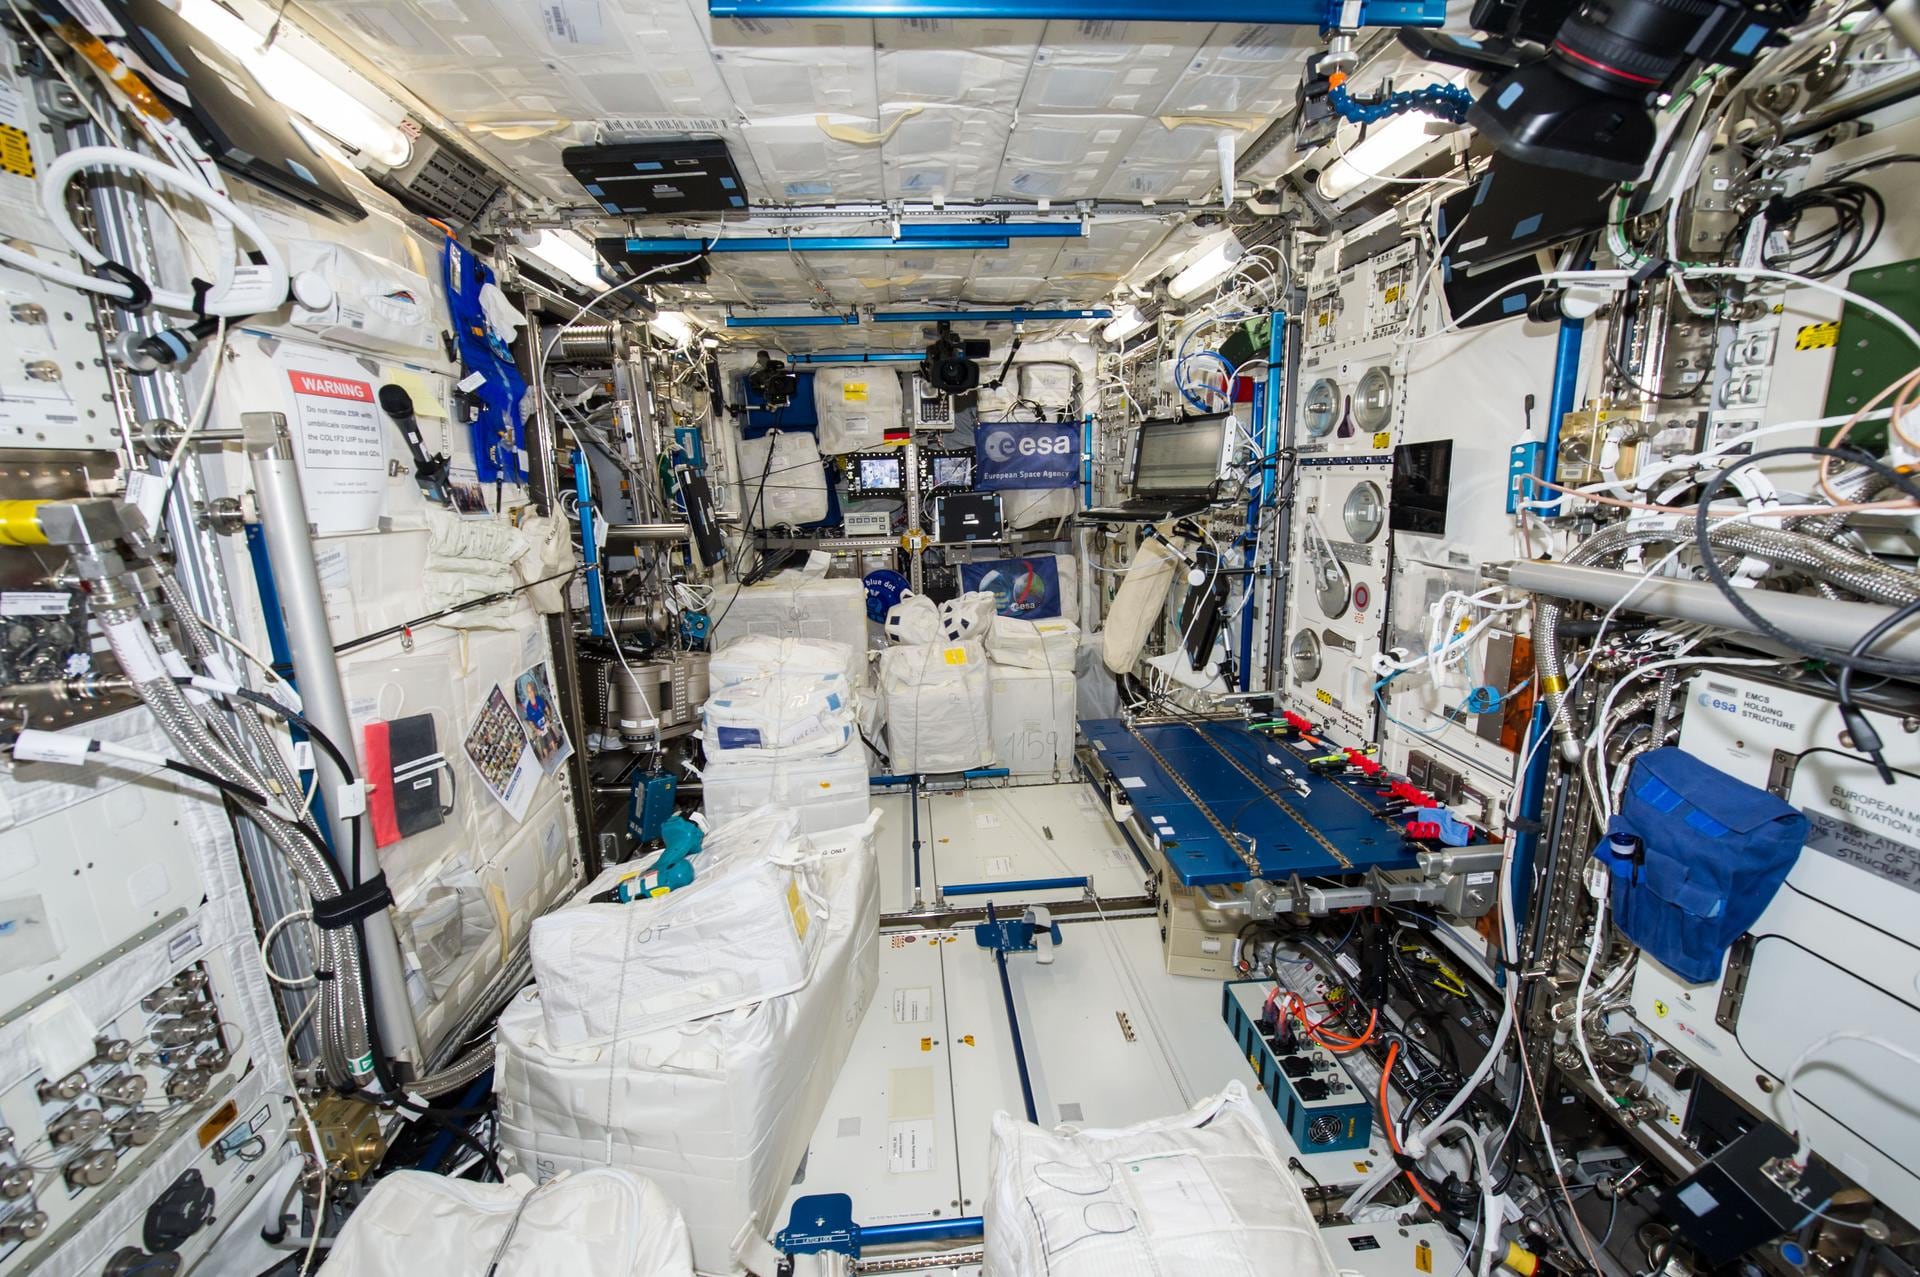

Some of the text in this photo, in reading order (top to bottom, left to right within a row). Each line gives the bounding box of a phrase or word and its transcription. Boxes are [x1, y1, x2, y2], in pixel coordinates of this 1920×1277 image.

[301, 377, 364, 398] WARNING
[317, 407, 328, 415] not
[341, 423, 370, 432] connected
[308, 448, 332, 456] damage
[1019, 435, 1070, 455] esa
[1043, 470, 1070, 478] Agency
[865, 578, 896, 592] blue dot
[1019, 602, 1036, 610] esa
[1745, 691, 1771, 704] EMCS
[1712, 698, 1738, 713] esa
[1743, 701, 1784, 717] HOLDING
[1742, 710, 1796, 731] STRUCTURE
[1832, 785, 1904, 817] EUROPEAN
[1829, 798, 1913, 834] CULTIVATION
[1811, 823, 1829, 837] THE
[1835, 832, 1880, 854] FRONT
[1884, 852, 1904, 864] OF
[1818, 815, 1920, 860] DO NOT ATTAC
[830, 847, 847, 855] ONLY
[1837, 848, 1912, 881] STRUCTURE
